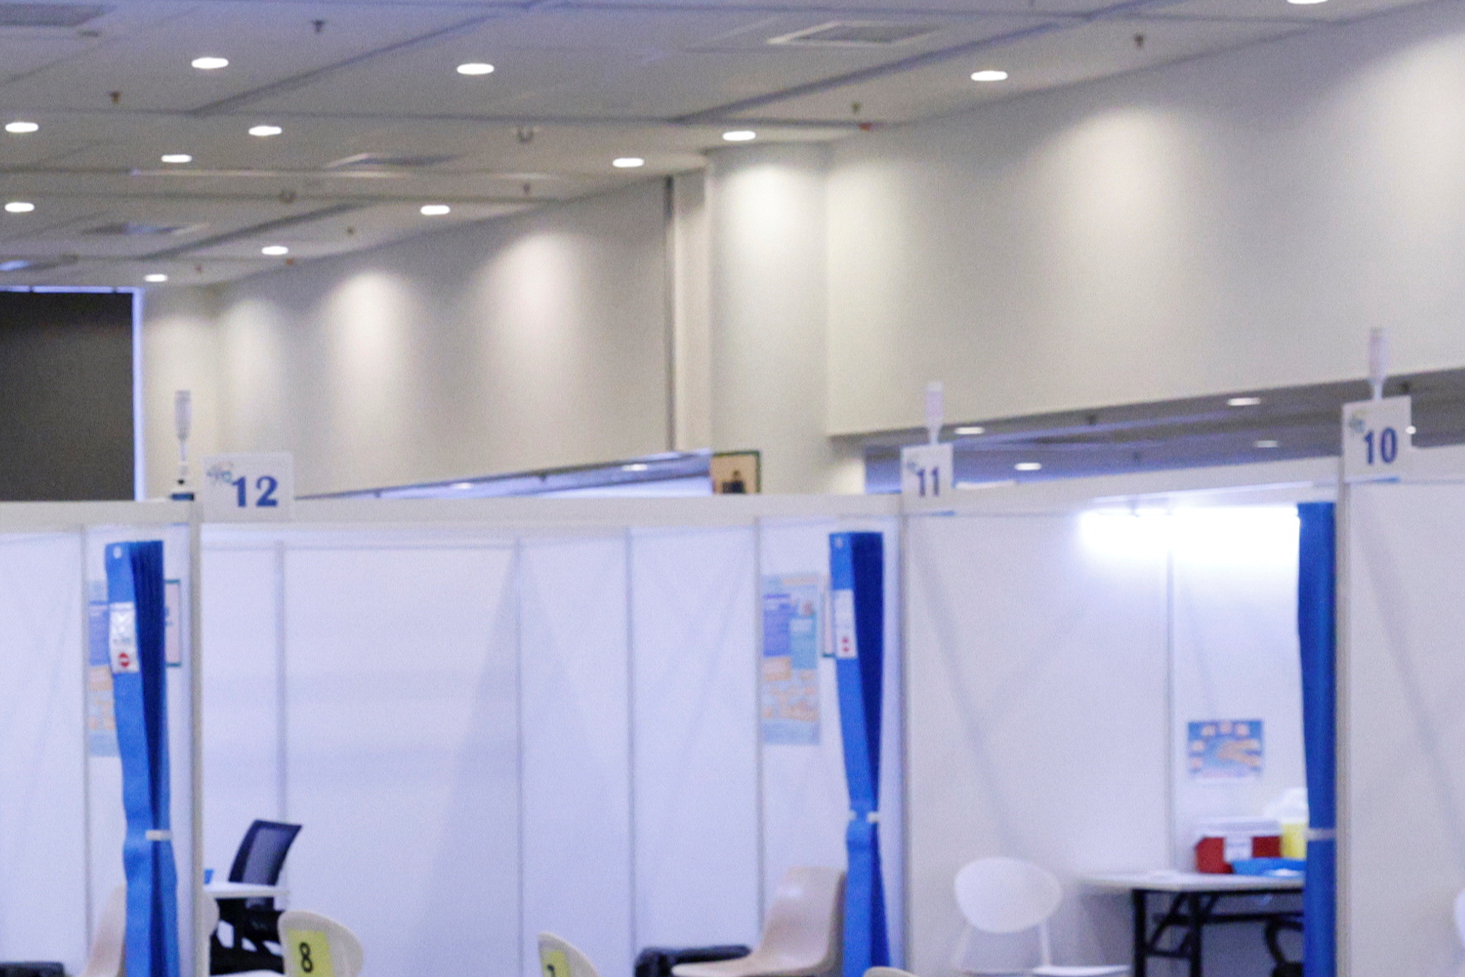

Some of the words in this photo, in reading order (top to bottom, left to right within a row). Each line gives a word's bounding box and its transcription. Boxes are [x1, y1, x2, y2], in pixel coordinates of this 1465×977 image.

[1363, 426, 1398, 465] 10
[232, 475, 279, 508] 12
[917, 465, 940, 497] 11
[299, 941, 314, 974] 8
